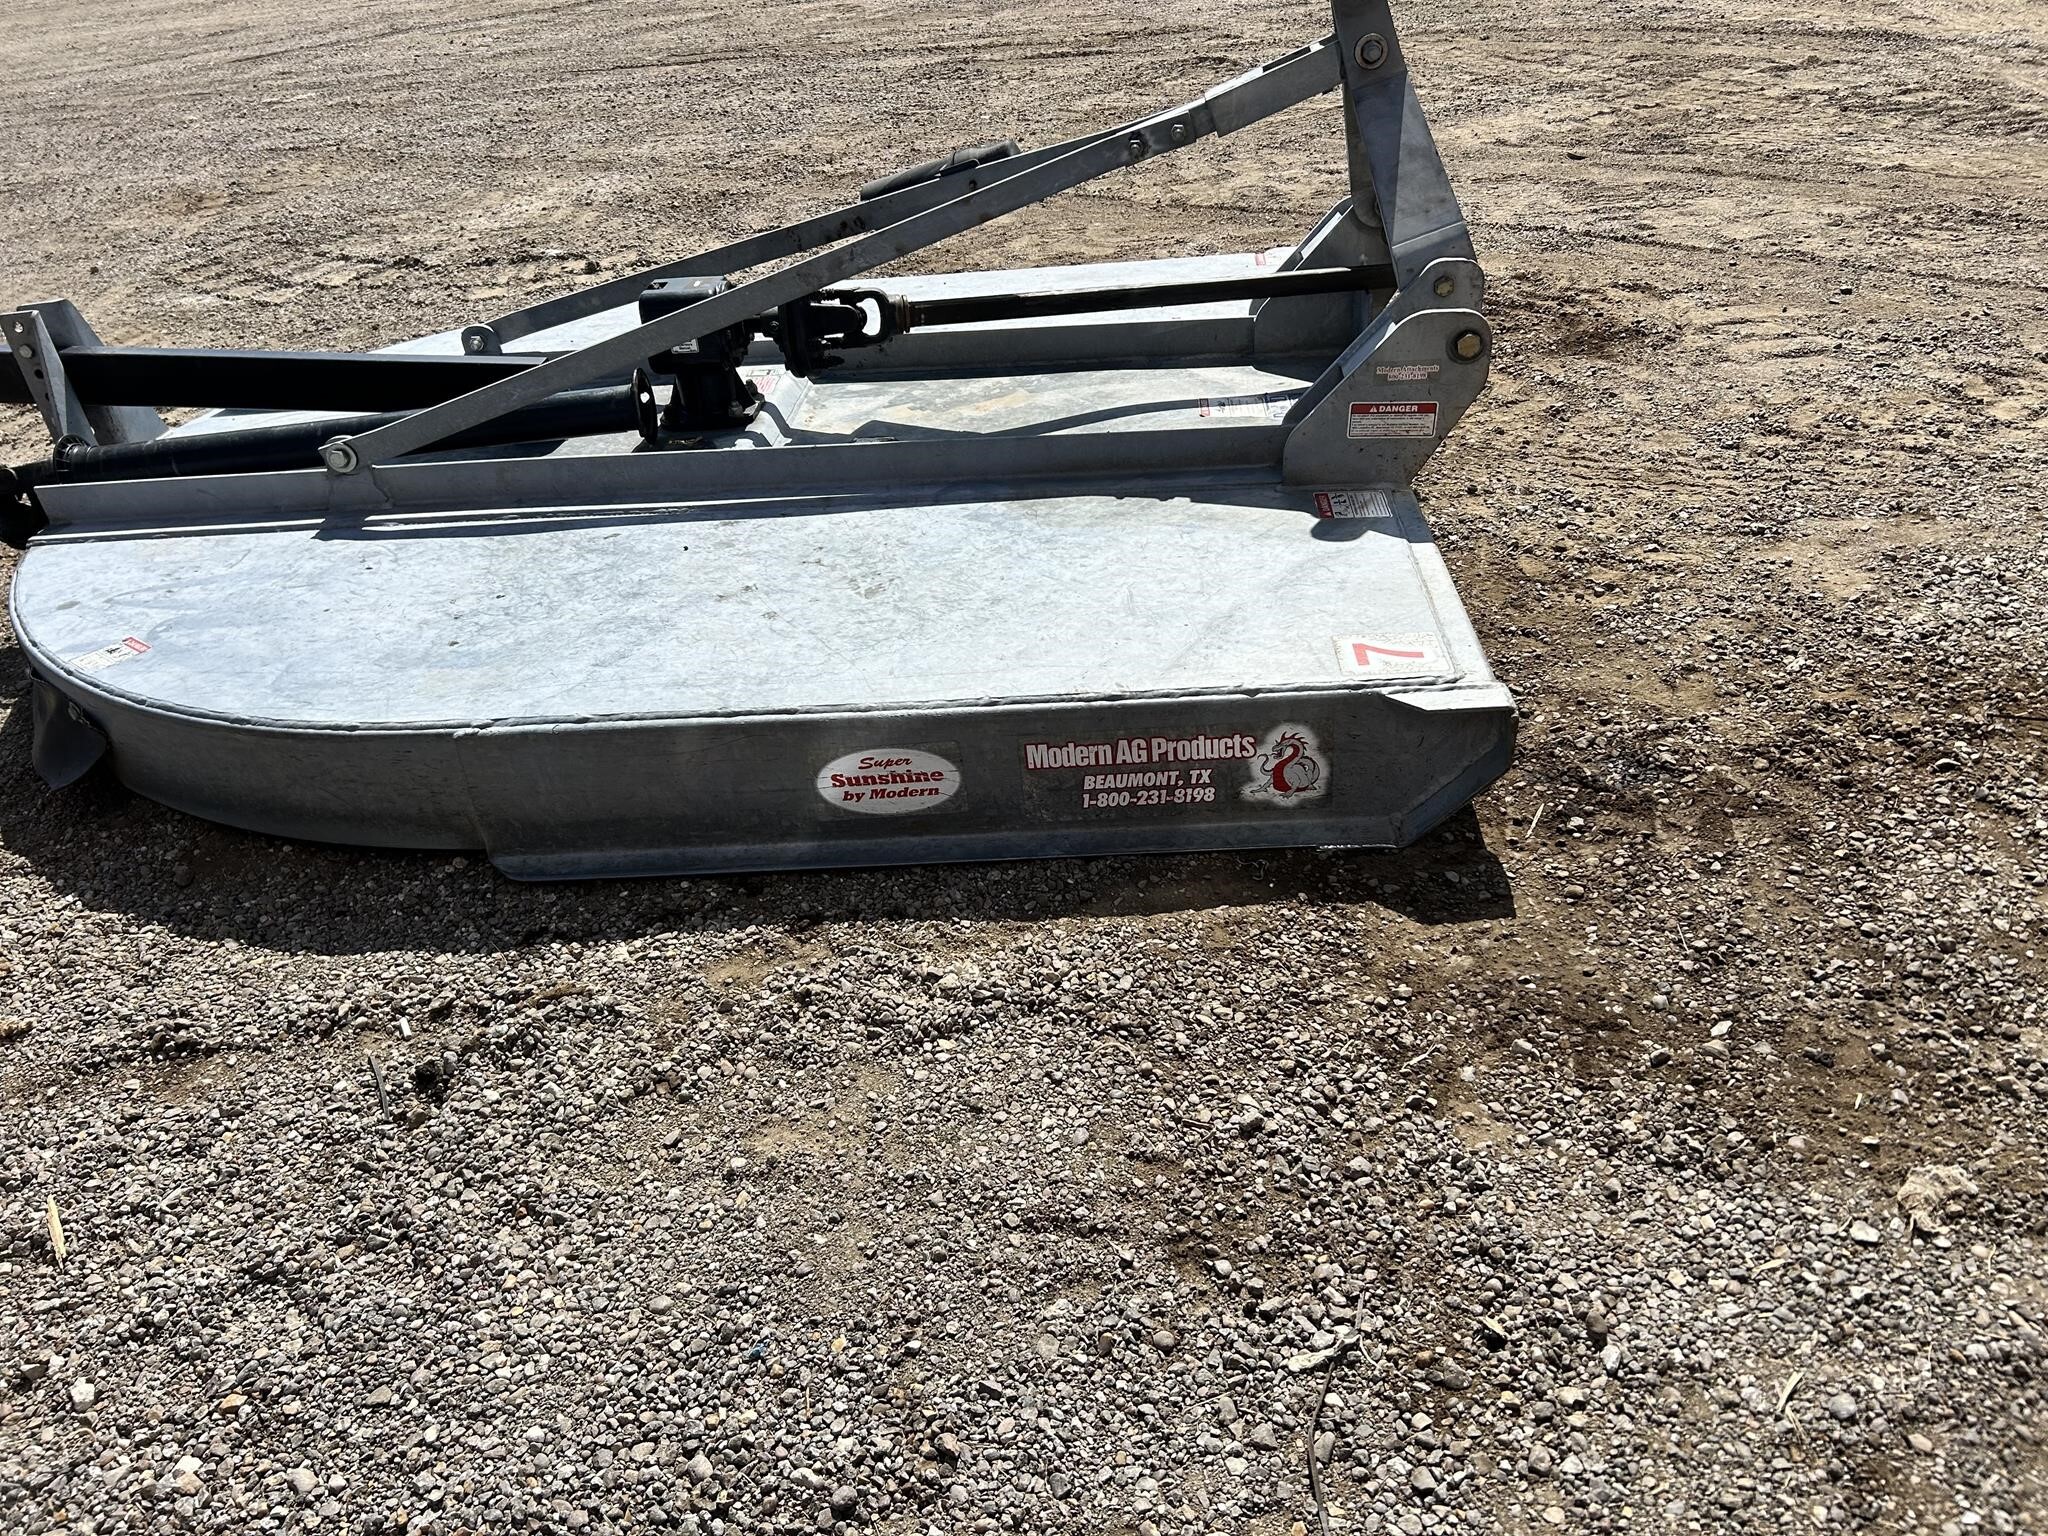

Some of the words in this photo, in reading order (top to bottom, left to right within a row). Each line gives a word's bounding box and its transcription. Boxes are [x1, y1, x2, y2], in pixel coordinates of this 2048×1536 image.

[1352, 643, 1424, 665] 7
[1025, 742, 1113, 769] Modern
[1115, 738, 1149, 765] AG
[1151, 733, 1257, 762] Products
[858, 757, 912, 770] Super
[830, 769, 945, 788] Sunshine
[1083, 771, 1184, 790] BEAUMONT,
[1189, 769, 1213, 784] TX
[842, 790, 866, 802] by
[869, 787, 940, 800] Modern
[1082, 786, 1216, 808] 1-800-231-8198
